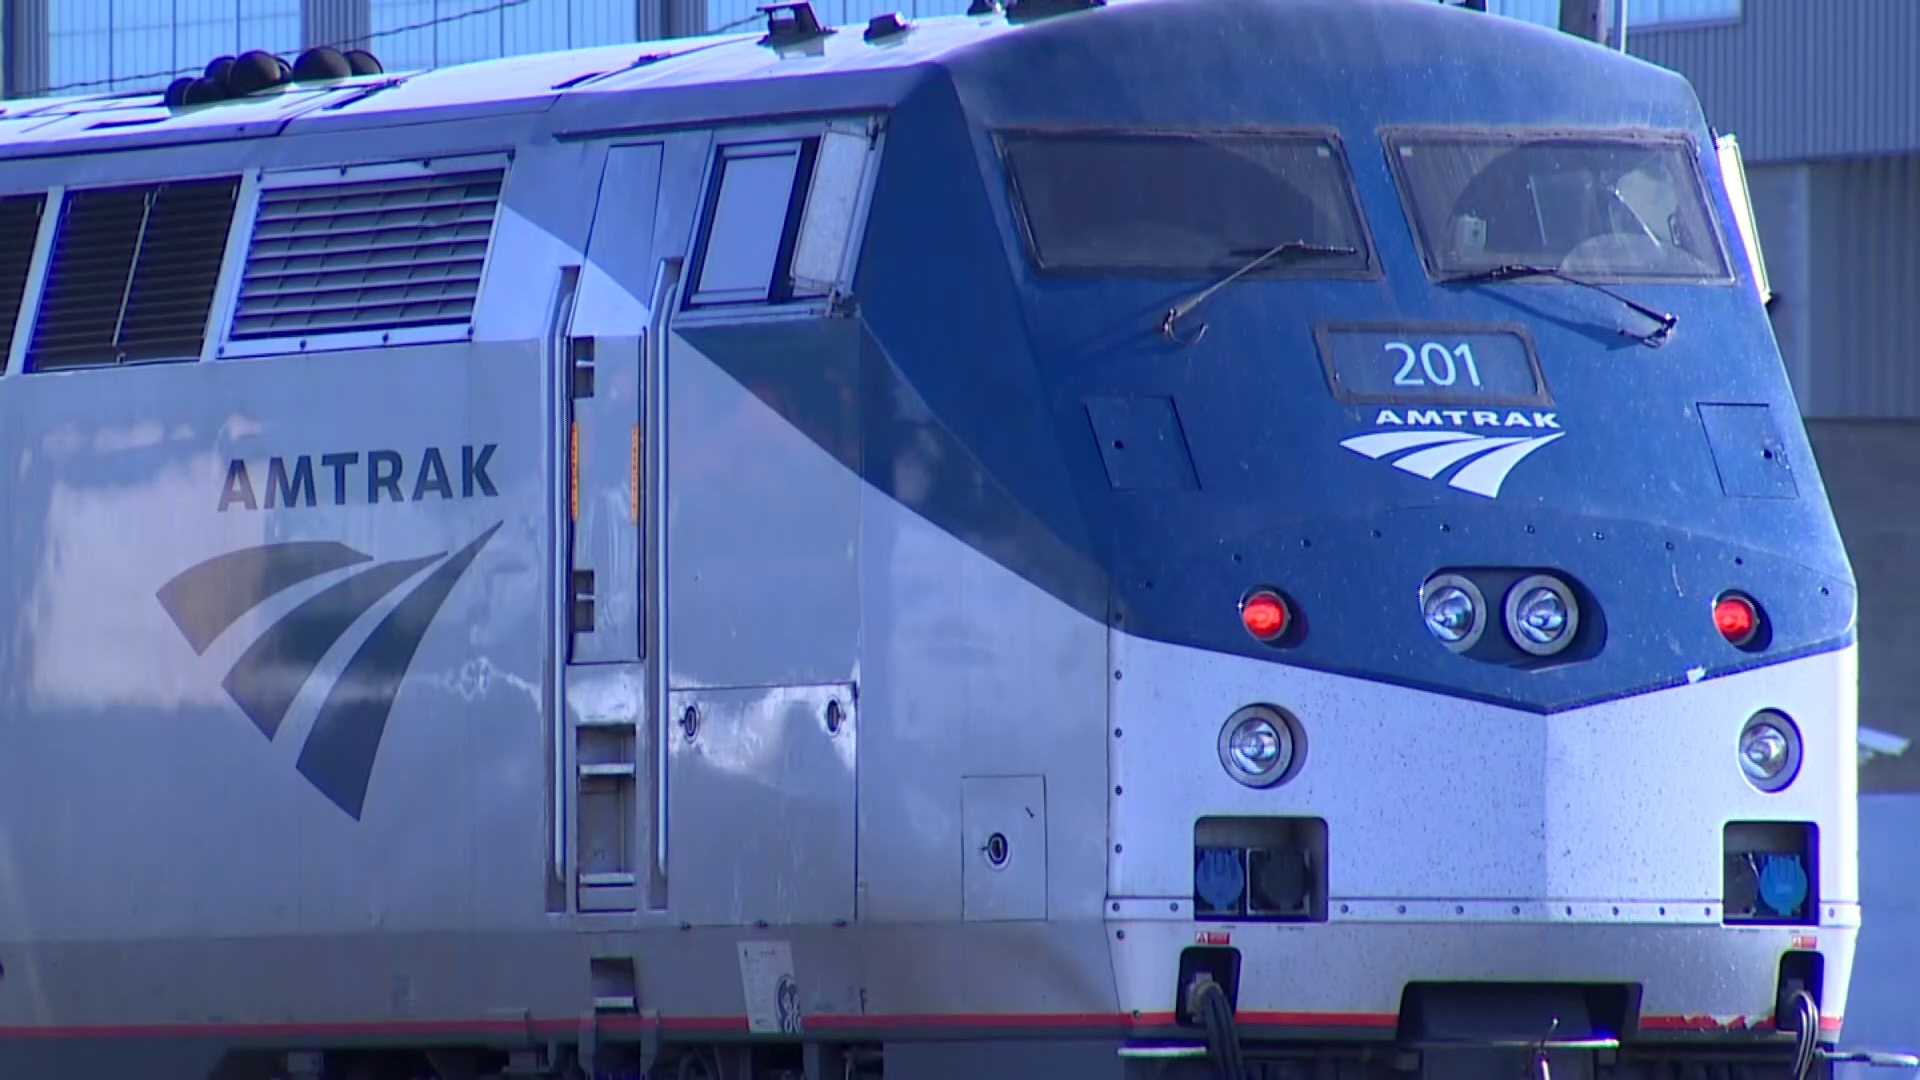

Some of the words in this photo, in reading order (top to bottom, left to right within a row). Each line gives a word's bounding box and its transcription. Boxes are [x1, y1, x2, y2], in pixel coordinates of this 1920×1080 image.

[1384, 342, 1481, 387] 201
[1375, 409, 1560, 429] AMTRAK
[217, 443, 499, 512] AMTRAK
